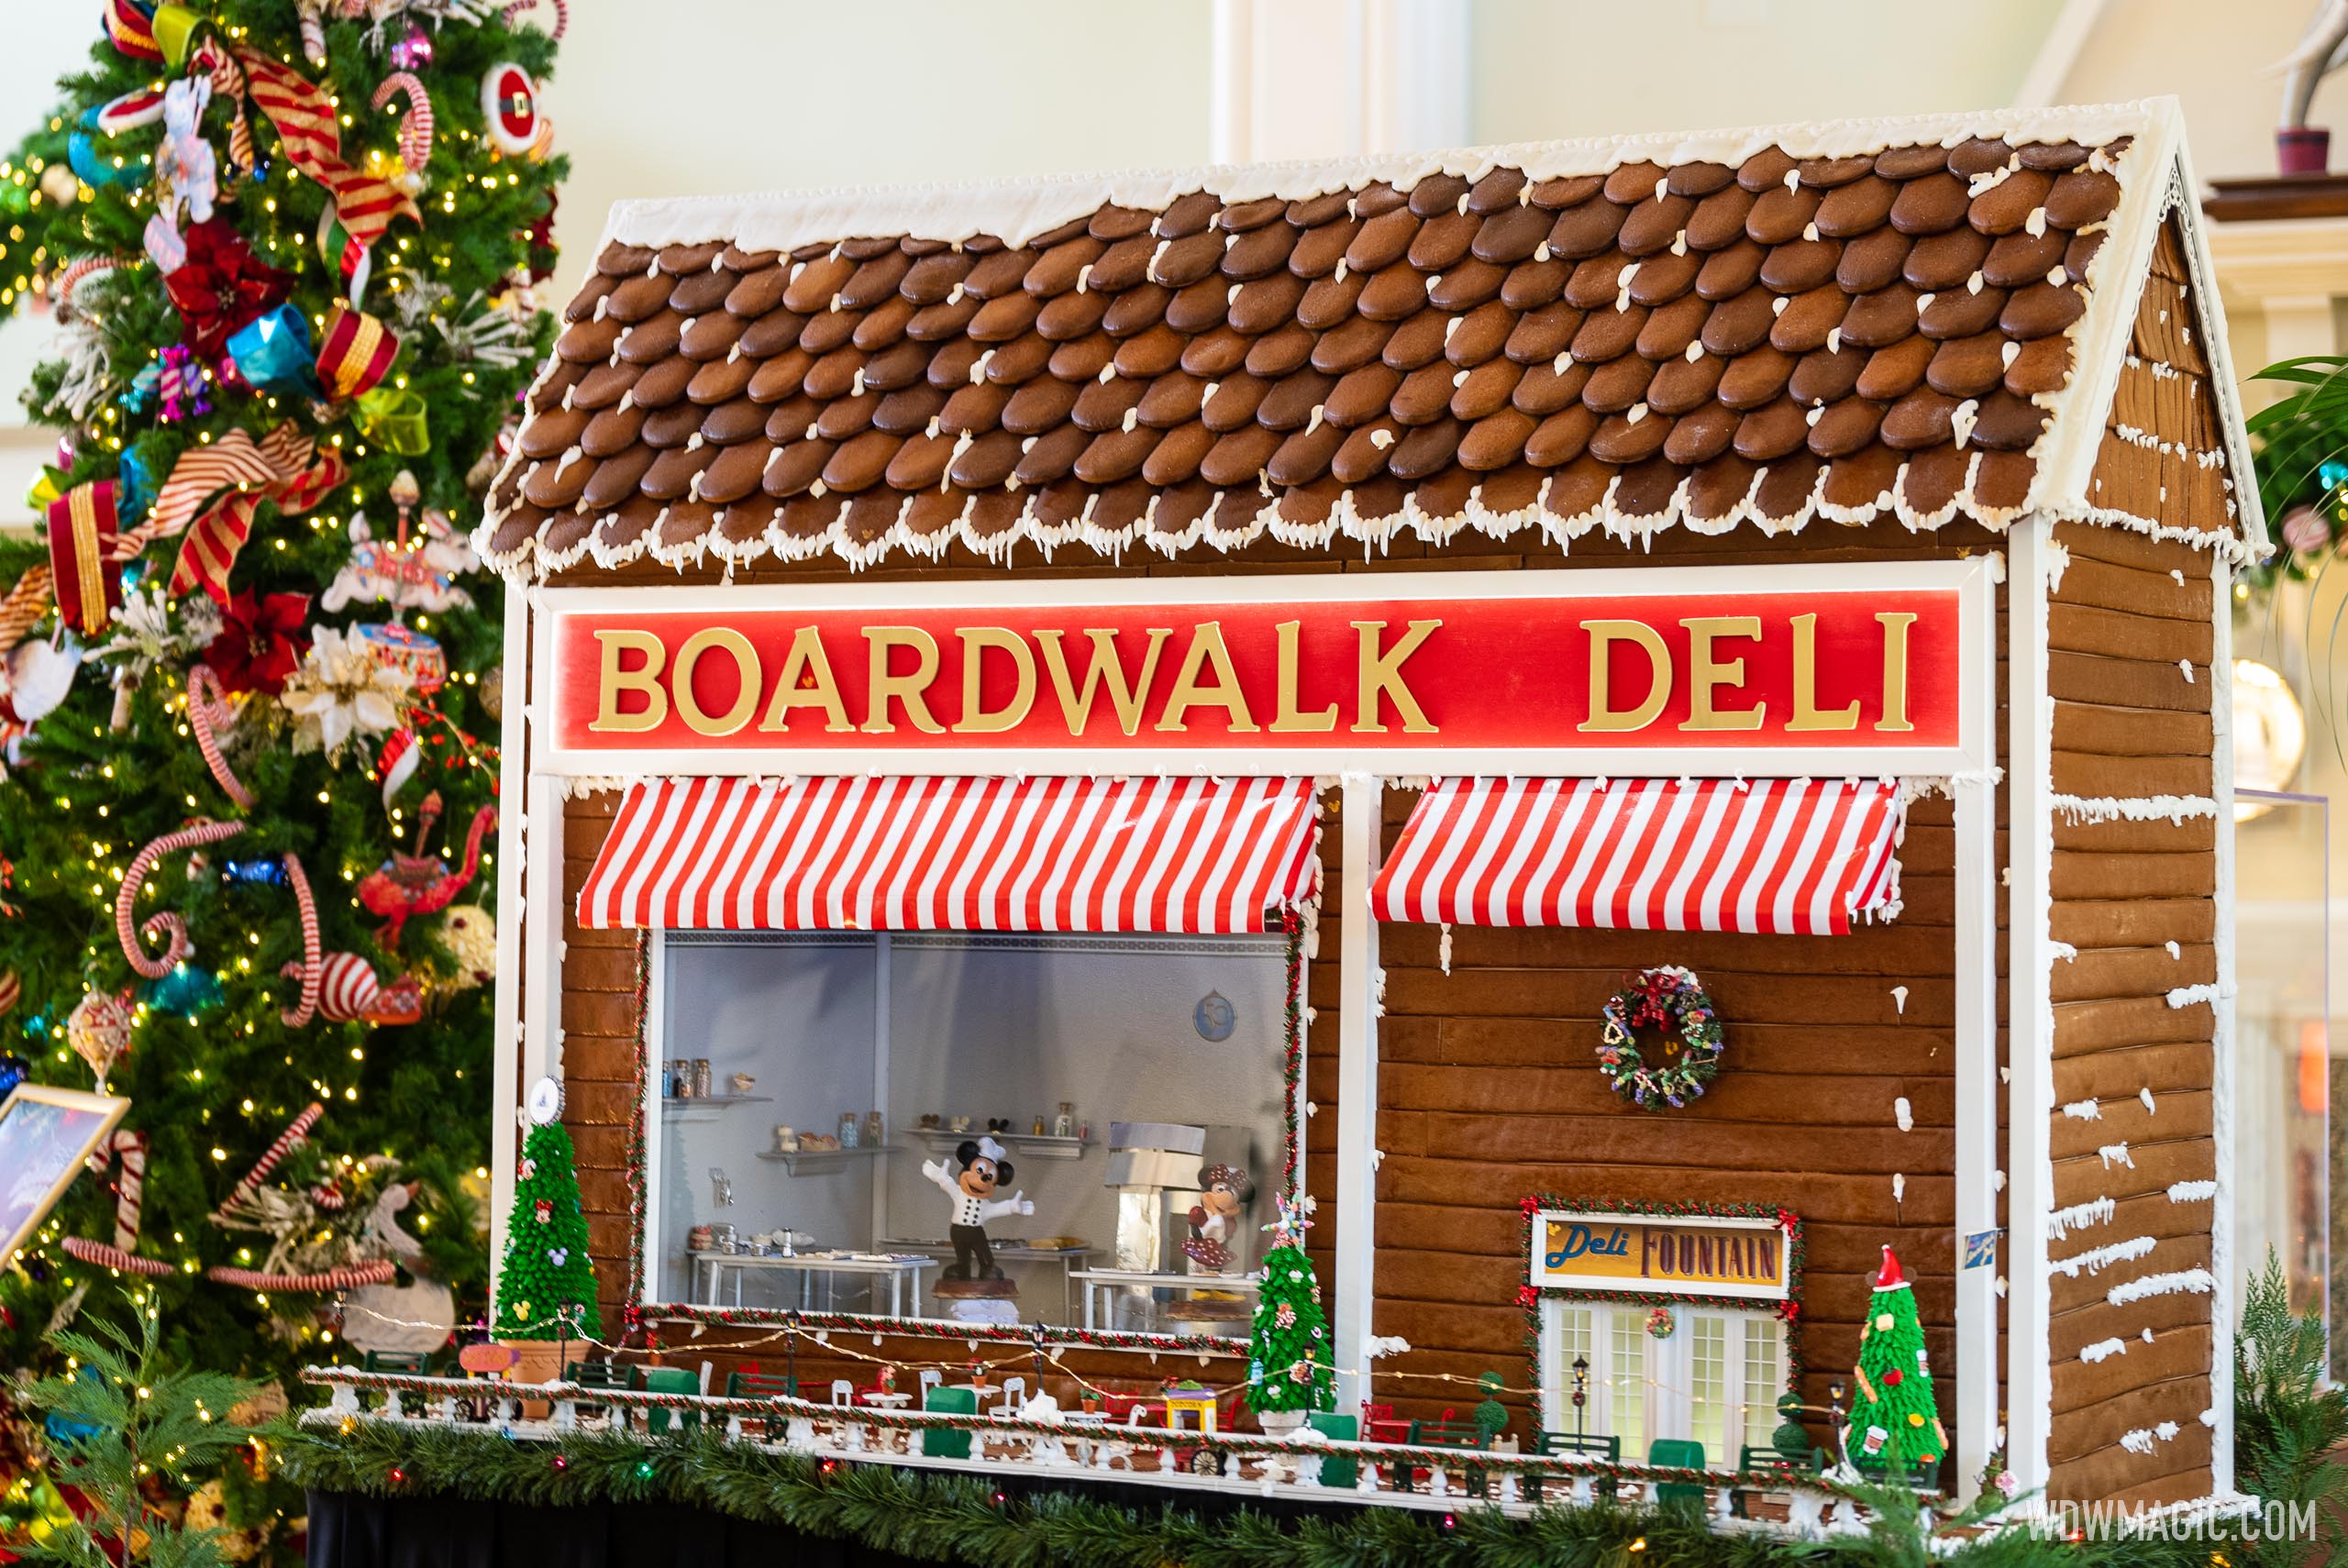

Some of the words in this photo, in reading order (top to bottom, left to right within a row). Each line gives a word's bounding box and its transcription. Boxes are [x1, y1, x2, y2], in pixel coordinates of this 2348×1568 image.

[588, 619, 1443, 736] BOARDWALK
[1577, 612, 1918, 733] DELI
[1545, 1224, 1630, 1268] Deli
[1641, 1227, 1777, 1279] FOUNTAIN
